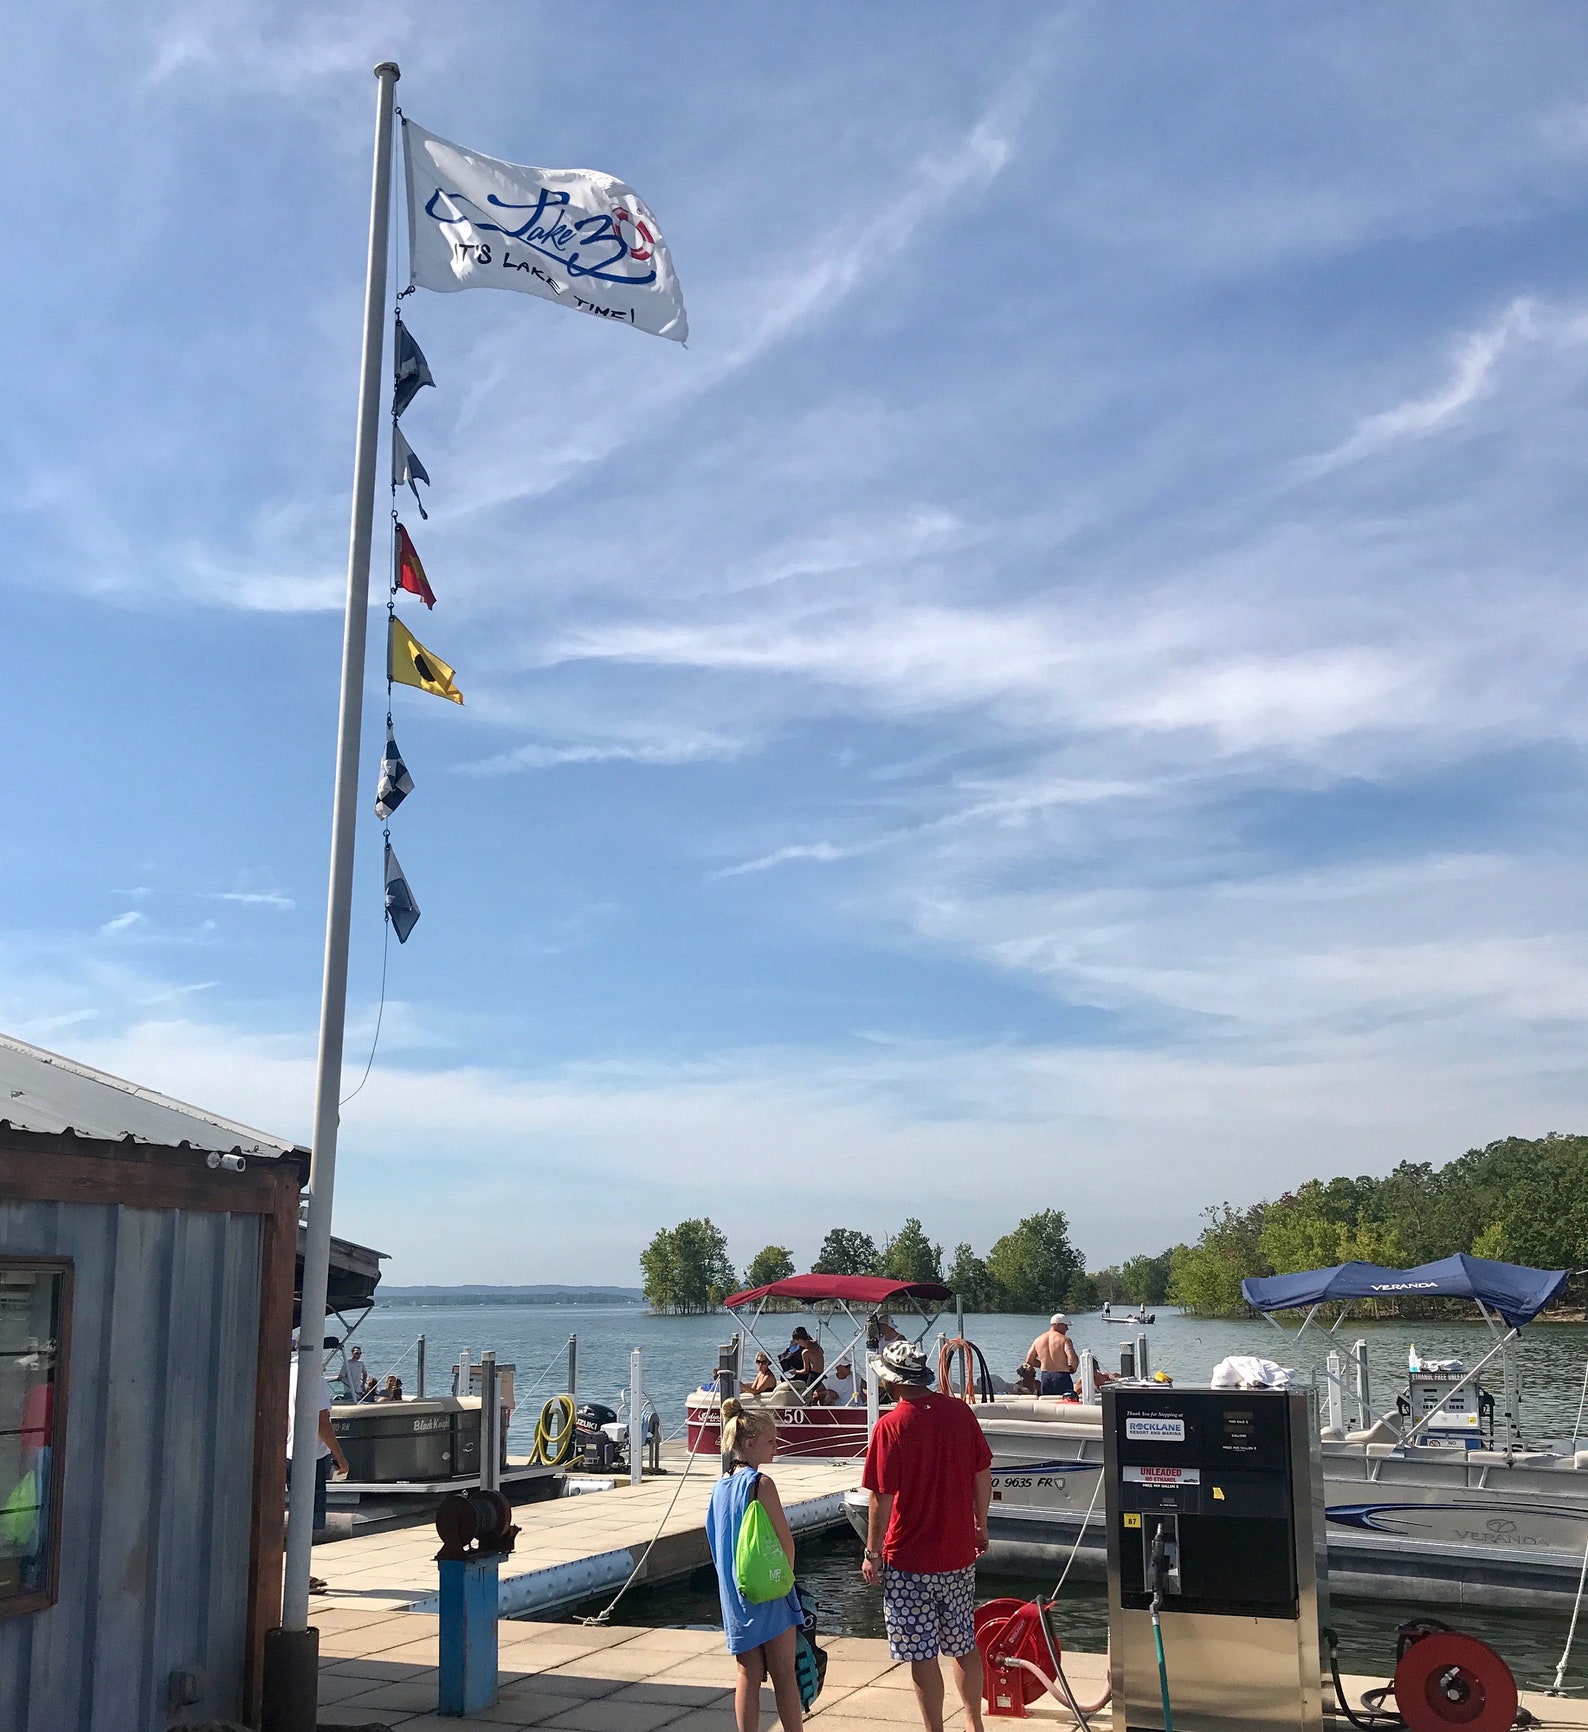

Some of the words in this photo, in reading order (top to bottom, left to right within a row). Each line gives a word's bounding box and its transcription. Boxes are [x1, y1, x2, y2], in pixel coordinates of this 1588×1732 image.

[454, 244, 492, 265] IT'S
[503, 252, 562, 296] LAKE
[573, 295, 635, 323] TIME!
[1370, 1282, 1438, 1291] VERANDA
[783, 1409, 804, 1424] 50
[413, 1418, 433, 1431] Black
[433, 1417, 450, 1431] Knigh
[1129, 1422, 1181, 1431] ROCKLANE
[1140, 1467, 1182, 1477] UNLEADED
[1003, 1477, 1033, 1488] 9635
[1037, 1477, 1053, 1488] FR
[1452, 1529, 1550, 1547] VERANDA
